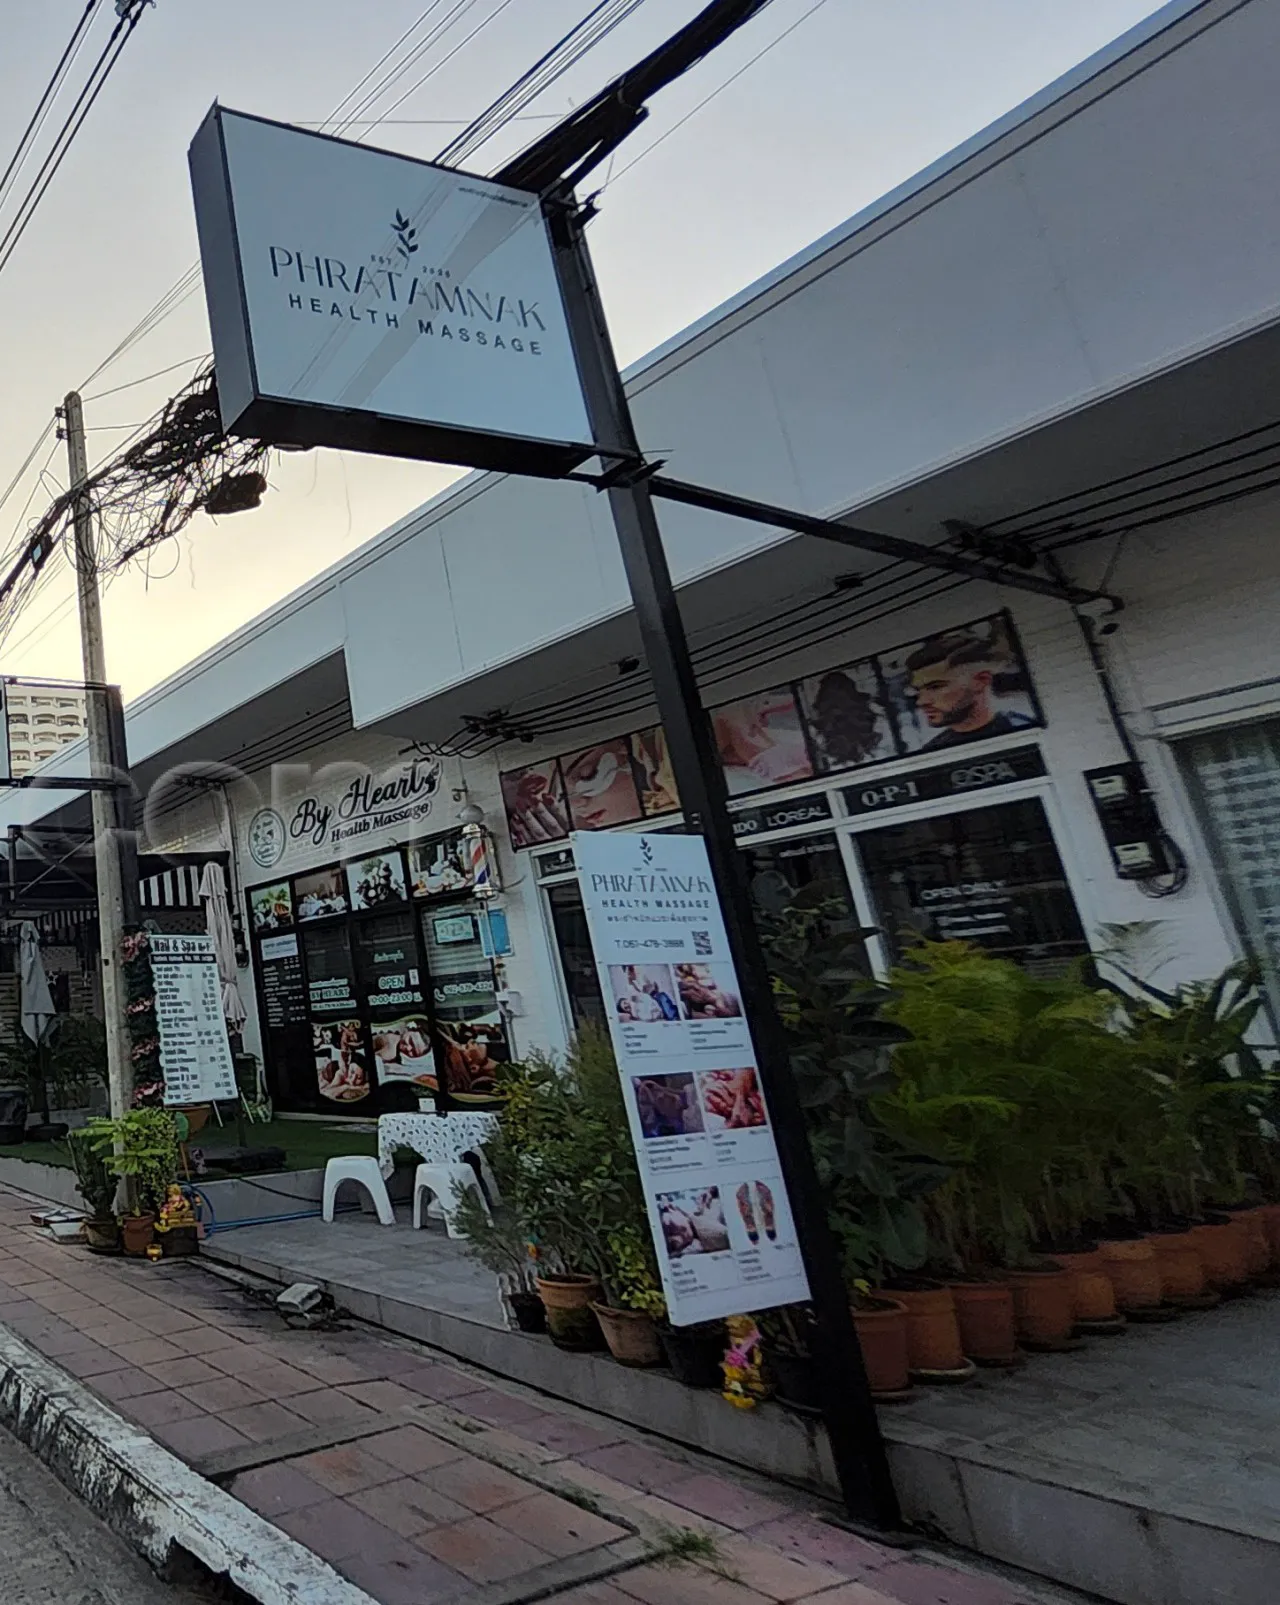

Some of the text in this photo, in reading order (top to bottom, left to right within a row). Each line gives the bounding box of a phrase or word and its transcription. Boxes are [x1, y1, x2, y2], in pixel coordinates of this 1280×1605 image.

[268, 244, 548, 332] PHRATAMNAK
[288, 292, 543, 357] HEALTH MASSAGE
[289, 797, 333, 846] By
[330, 801, 430, 843] Health Massage
[601, 899, 710, 909] HEALTH MASSAGE
[181, 940, 196, 953] Spa
[379, 975, 405, 988] OPEN
